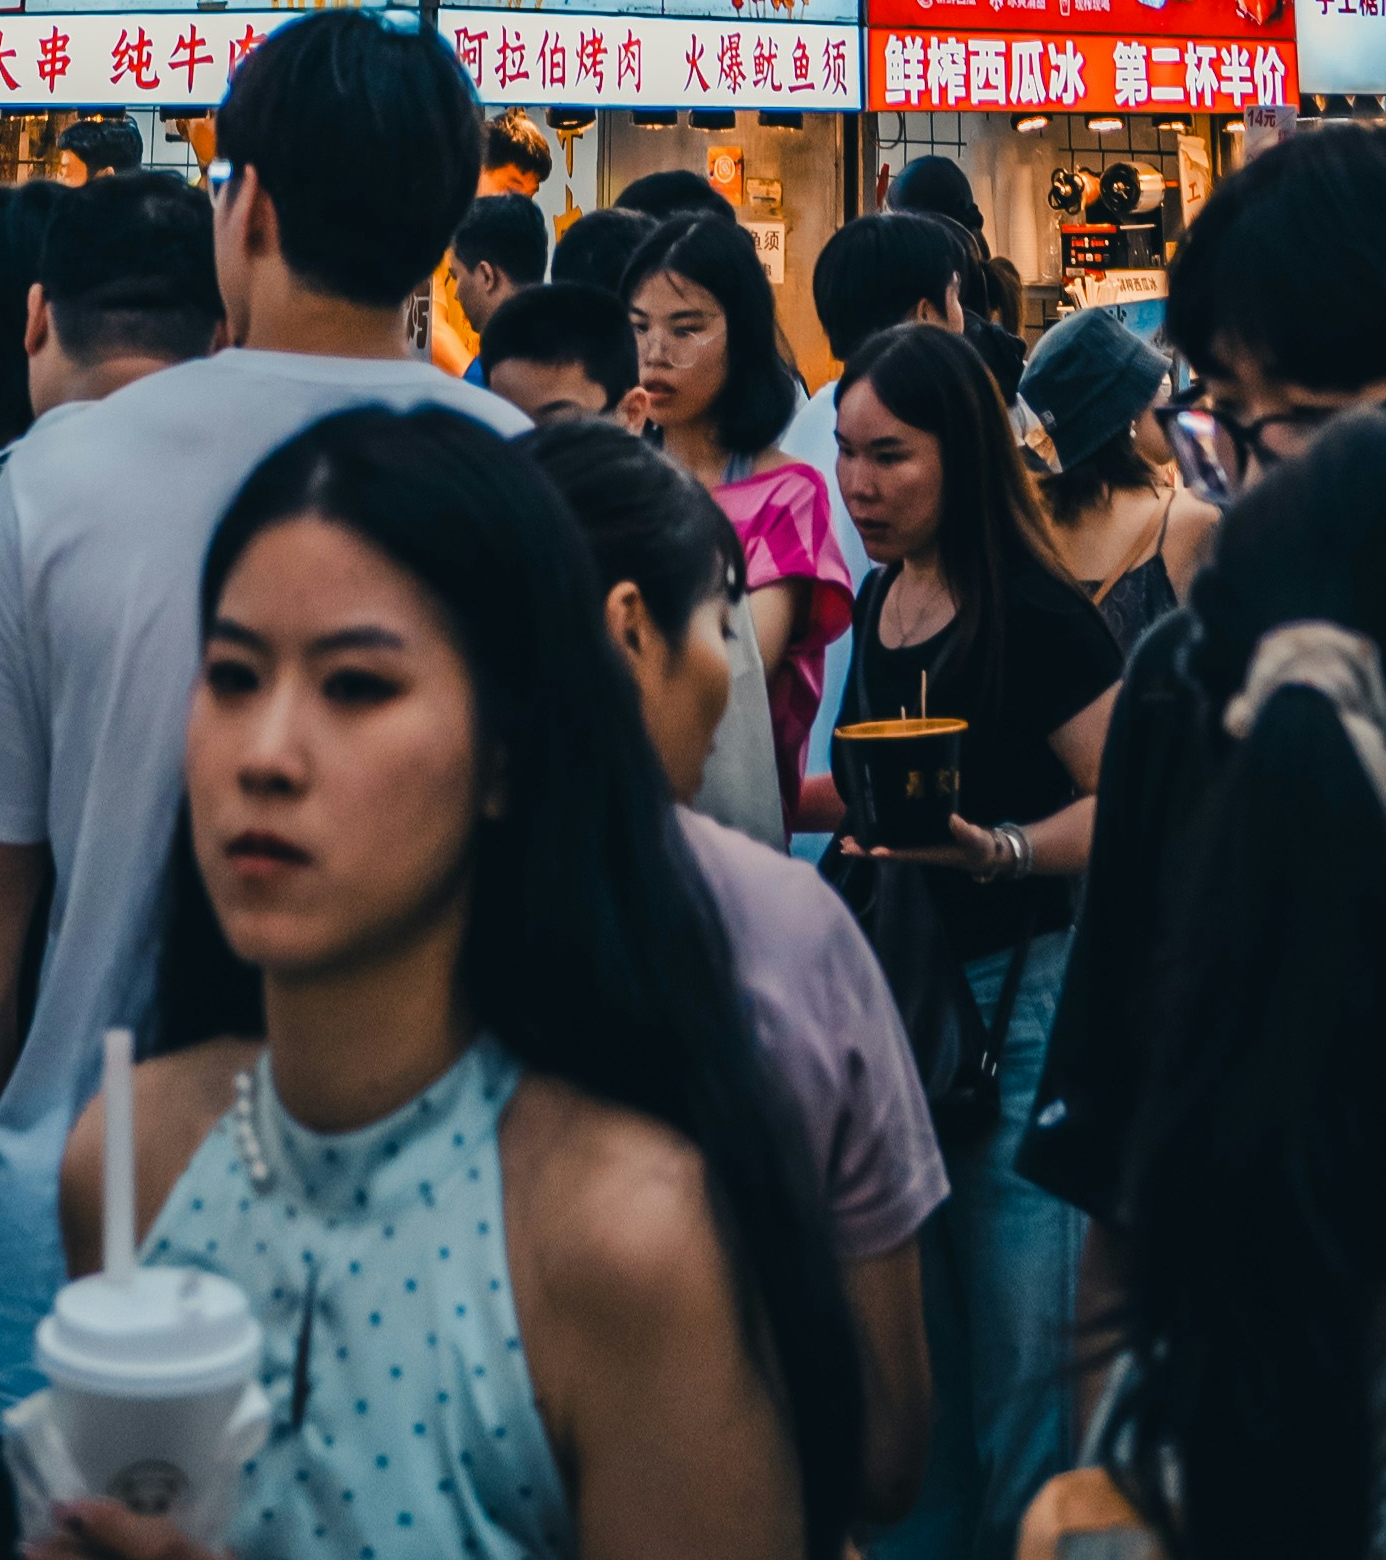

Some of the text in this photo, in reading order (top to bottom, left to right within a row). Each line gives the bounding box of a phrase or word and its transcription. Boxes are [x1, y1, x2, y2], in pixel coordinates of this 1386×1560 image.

[453, 25, 644, 97] 阿拉伯烤肉
[683, 34, 848, 97] 火爆鱿鱼须
[883, 35, 1286, 107] 鲜榨西瓜冰 第二杯半价
